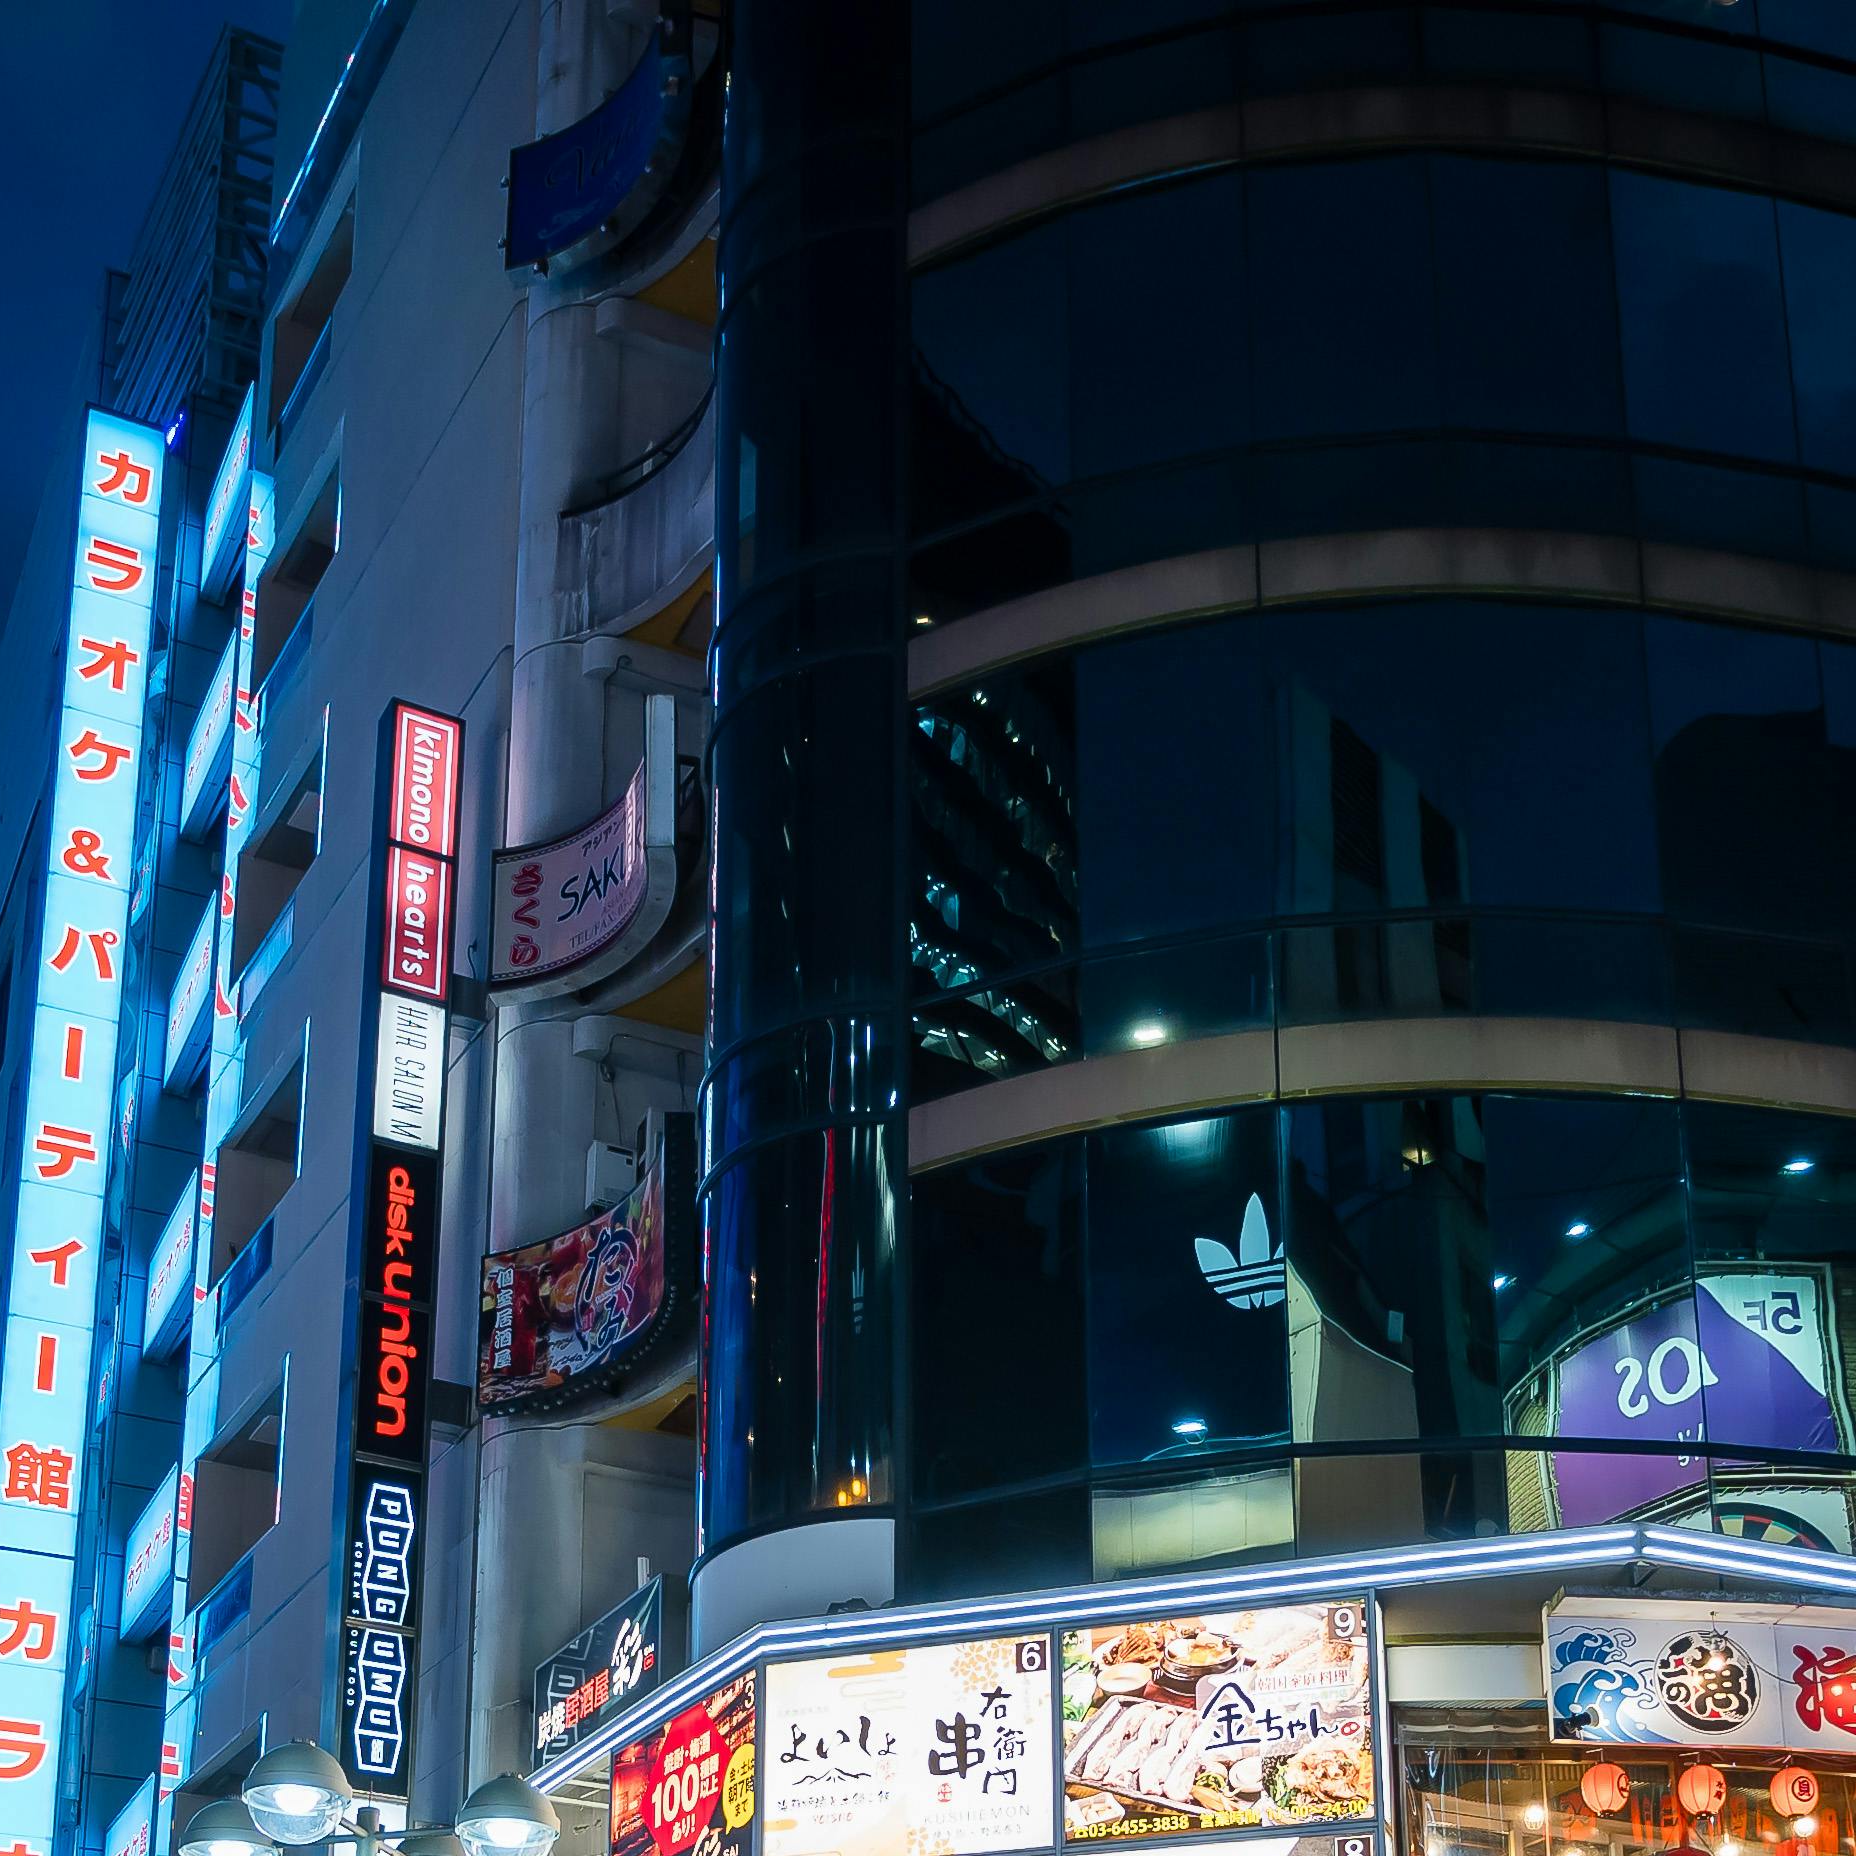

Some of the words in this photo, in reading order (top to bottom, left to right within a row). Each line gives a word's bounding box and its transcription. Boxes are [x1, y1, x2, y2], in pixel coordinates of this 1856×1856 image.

[408, 726, 442, 845] kimono
[401, 861, 435, 978] hearts
[509, 862, 544, 967] さくら
[1, 448, 154, 1511] カラオケ&パーティー館
[397, 1005, 428, 1050] HAIR
[393, 1055, 426, 1117] SALON
[386, 1166, 416, 1254] disk
[148, 1217, 193, 1317] カラオケ館
[579, 1226, 638, 1350] たくみ
[374, 1263, 415, 1437] union
[493, 1266, 514, 1371] 個室居酒屋
[125, 1510, 172, 1600] カラオケ館
[351, 1541, 363, 1600] KOREAN
[364, 1496, 404, 1731] PUNGUMU
[1333, 1608, 1356, 1637] 9
[346, 1666, 357, 1708] FOOD
[744, 1680, 756, 1710] 3
[1257, 1669, 1349, 1692] 韓国家庭料理
[780, 1714, 898, 1765] よいしょ
[928, 1711, 986, 1780] 串
[978, 1685, 1028, 1796] 右衛門
[1201, 1681, 1340, 1751] 金ちゃん
[650, 1763, 701, 1829] 100
[699, 1776, 719, 1801] 以上
[671, 1813, 696, 1844] あり!
[734, 1799, 749, 1818] まで
[1086, 1814, 1190, 1838] 03-6455-3838
[1198, 1808, 1261, 1828] 営業時間
